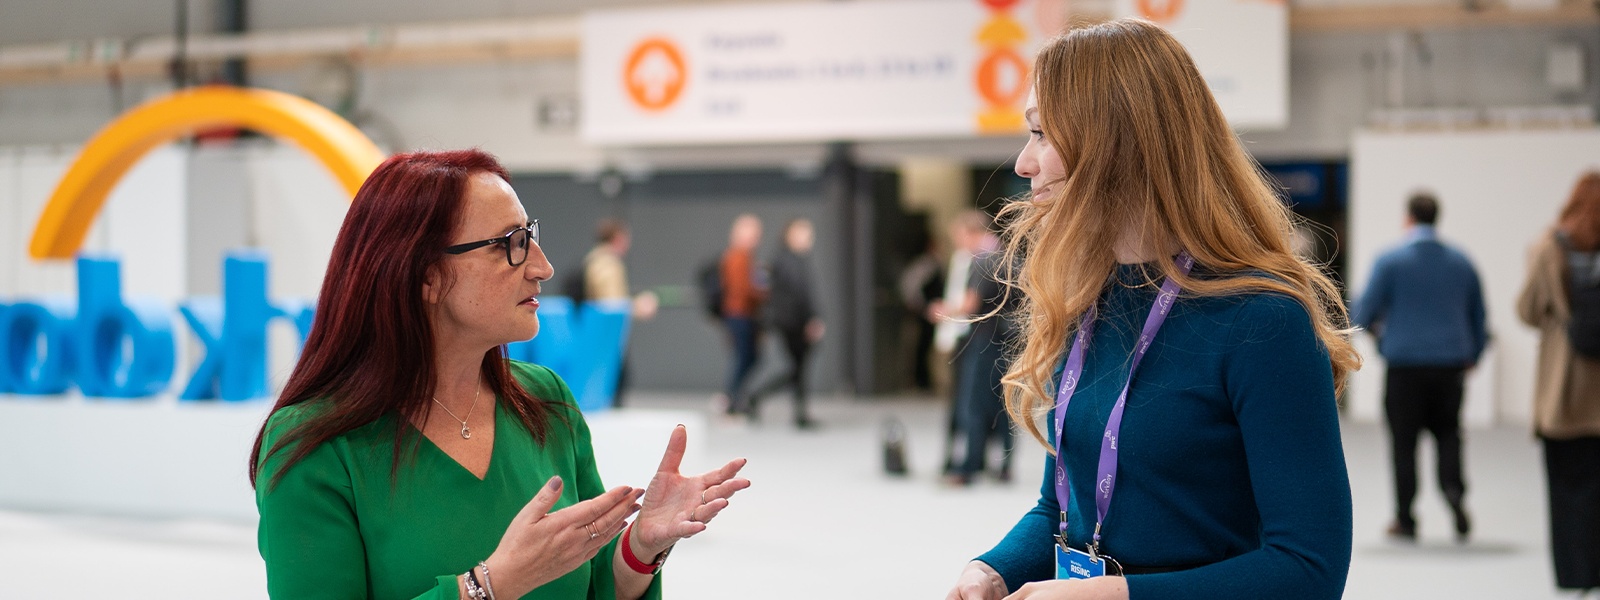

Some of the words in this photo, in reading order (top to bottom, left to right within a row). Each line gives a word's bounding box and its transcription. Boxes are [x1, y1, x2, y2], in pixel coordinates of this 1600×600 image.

[1160, 289, 1175, 315] workday
[1062, 369, 1074, 395] workday
[1103, 473, 1113, 499] workday
[1070, 564, 1091, 578] RISING
